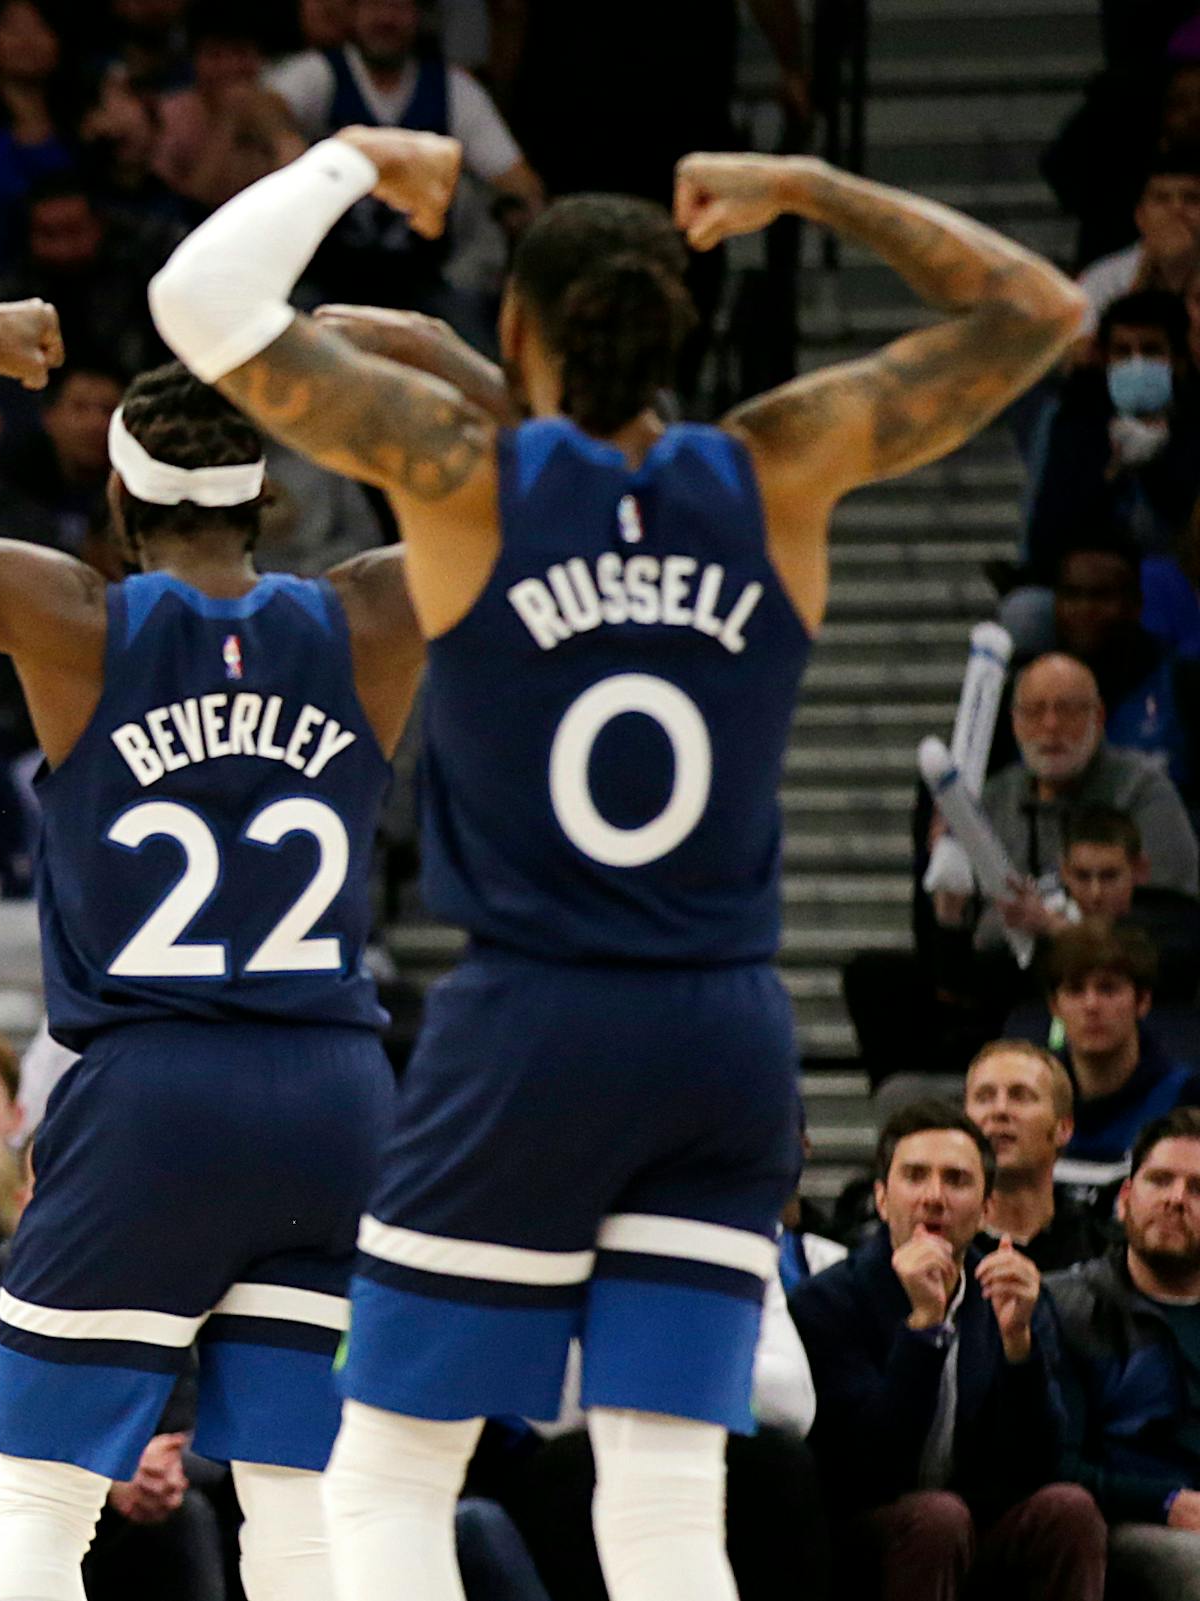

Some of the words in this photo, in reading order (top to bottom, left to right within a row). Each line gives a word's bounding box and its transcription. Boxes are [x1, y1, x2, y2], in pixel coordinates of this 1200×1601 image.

[506, 551, 764, 655] RUSSELL
[110, 692, 357, 788] BEVERLEY
[548, 672, 713, 868] 0
[106, 798, 349, 976] 22
